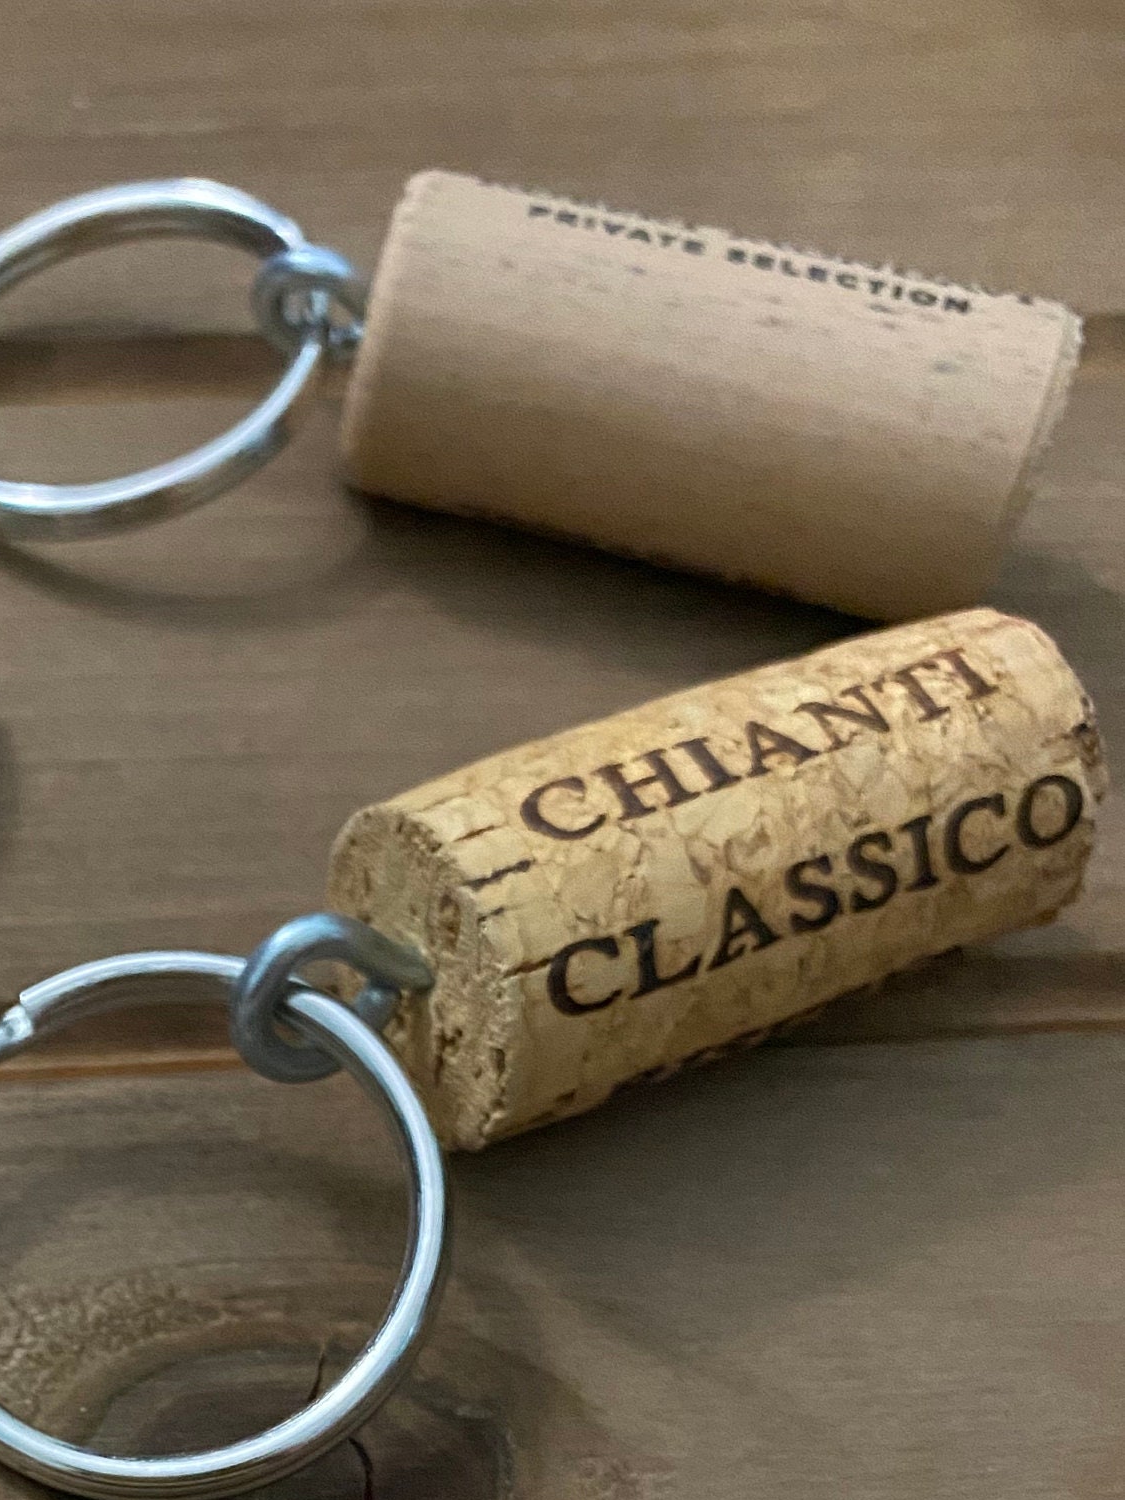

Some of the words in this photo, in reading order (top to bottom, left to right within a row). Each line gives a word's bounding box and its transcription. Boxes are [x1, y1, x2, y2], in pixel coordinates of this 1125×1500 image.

[527, 203, 706, 256] PRIVATE
[726, 246, 972, 315] SELECTION
[519, 648, 998, 841] CHIANTI
[546, 774, 1084, 1016] CLASSICO
